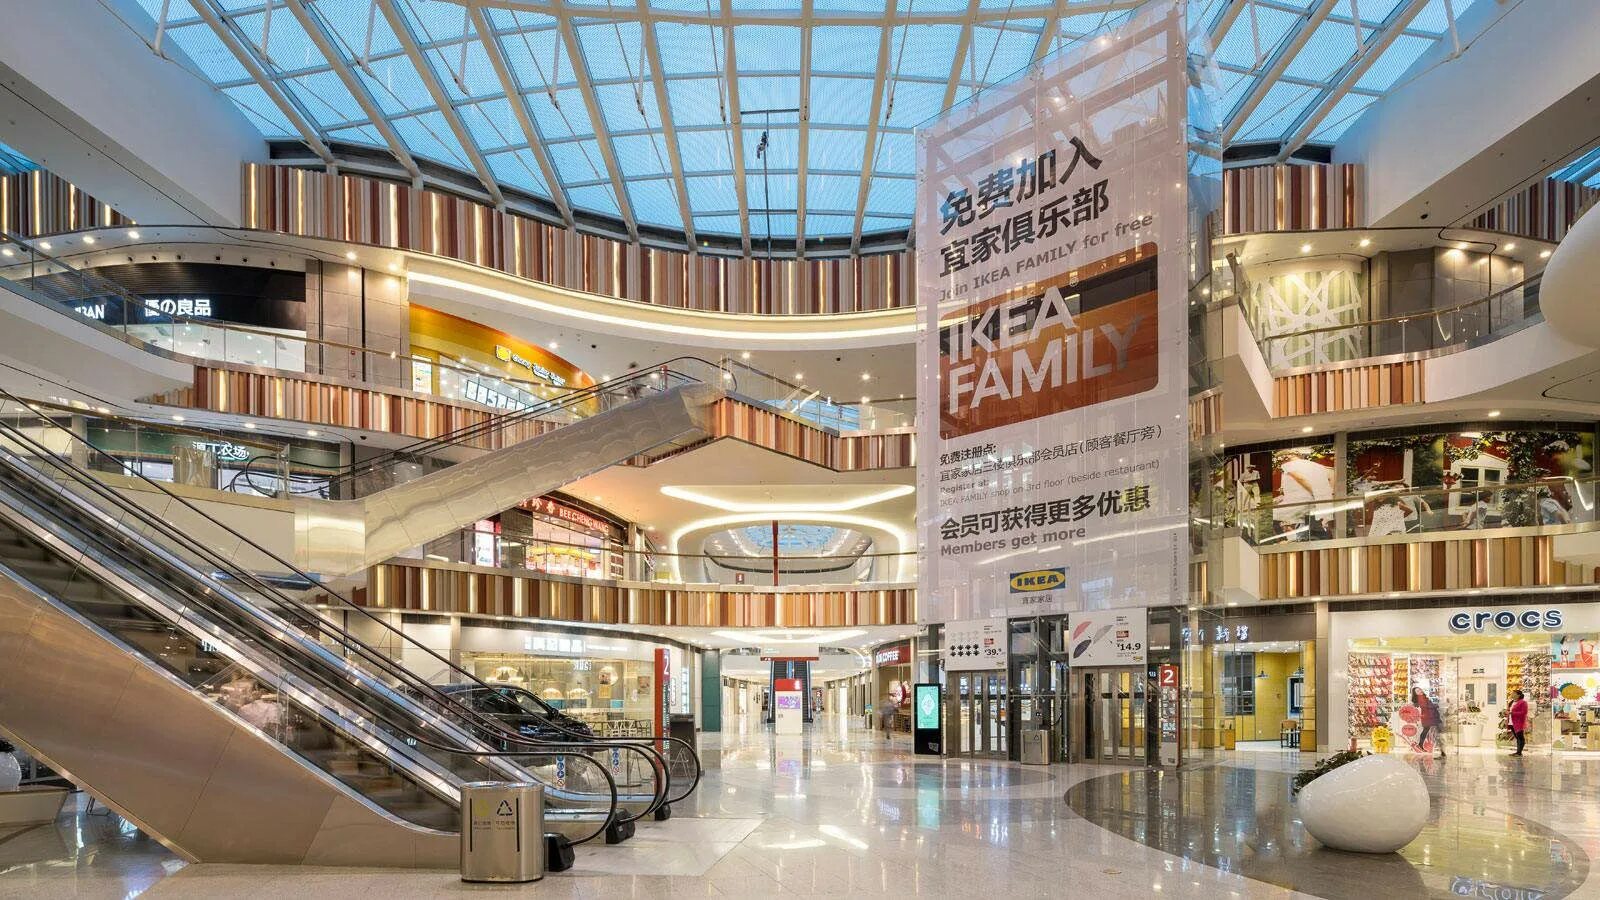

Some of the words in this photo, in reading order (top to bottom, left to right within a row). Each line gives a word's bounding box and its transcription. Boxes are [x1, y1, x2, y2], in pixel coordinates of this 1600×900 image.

[939, 136, 1103, 235] 免费加入
[939, 179, 1110, 278] 宜家俱乐部
[973, 266, 1010, 289] IKEA
[1016, 241, 1077, 274] FAMILY
[1083, 231, 1109, 248] for
[1115, 215, 1153, 237] free
[949, 285, 1077, 364] IKEA
[950, 313, 1147, 415] FAMILY
[940, 481, 975, 495] Register
[1013, 485, 1023, 494] on
[1044, 478, 1065, 488] floor
[1068, 471, 1101, 485] (beside
[1104, 459, 1161, 476] restaurant)
[939, 485, 1151, 540] 会员可获得更多优惠
[940, 538, 1006, 557] Members
[1011, 532, 1038, 549] get
[1042, 526, 1086, 543] more
[1017, 574, 1059, 587] IKEA
[1450, 609, 1564, 631] crocs
[1164, 669, 1174, 683] 2
